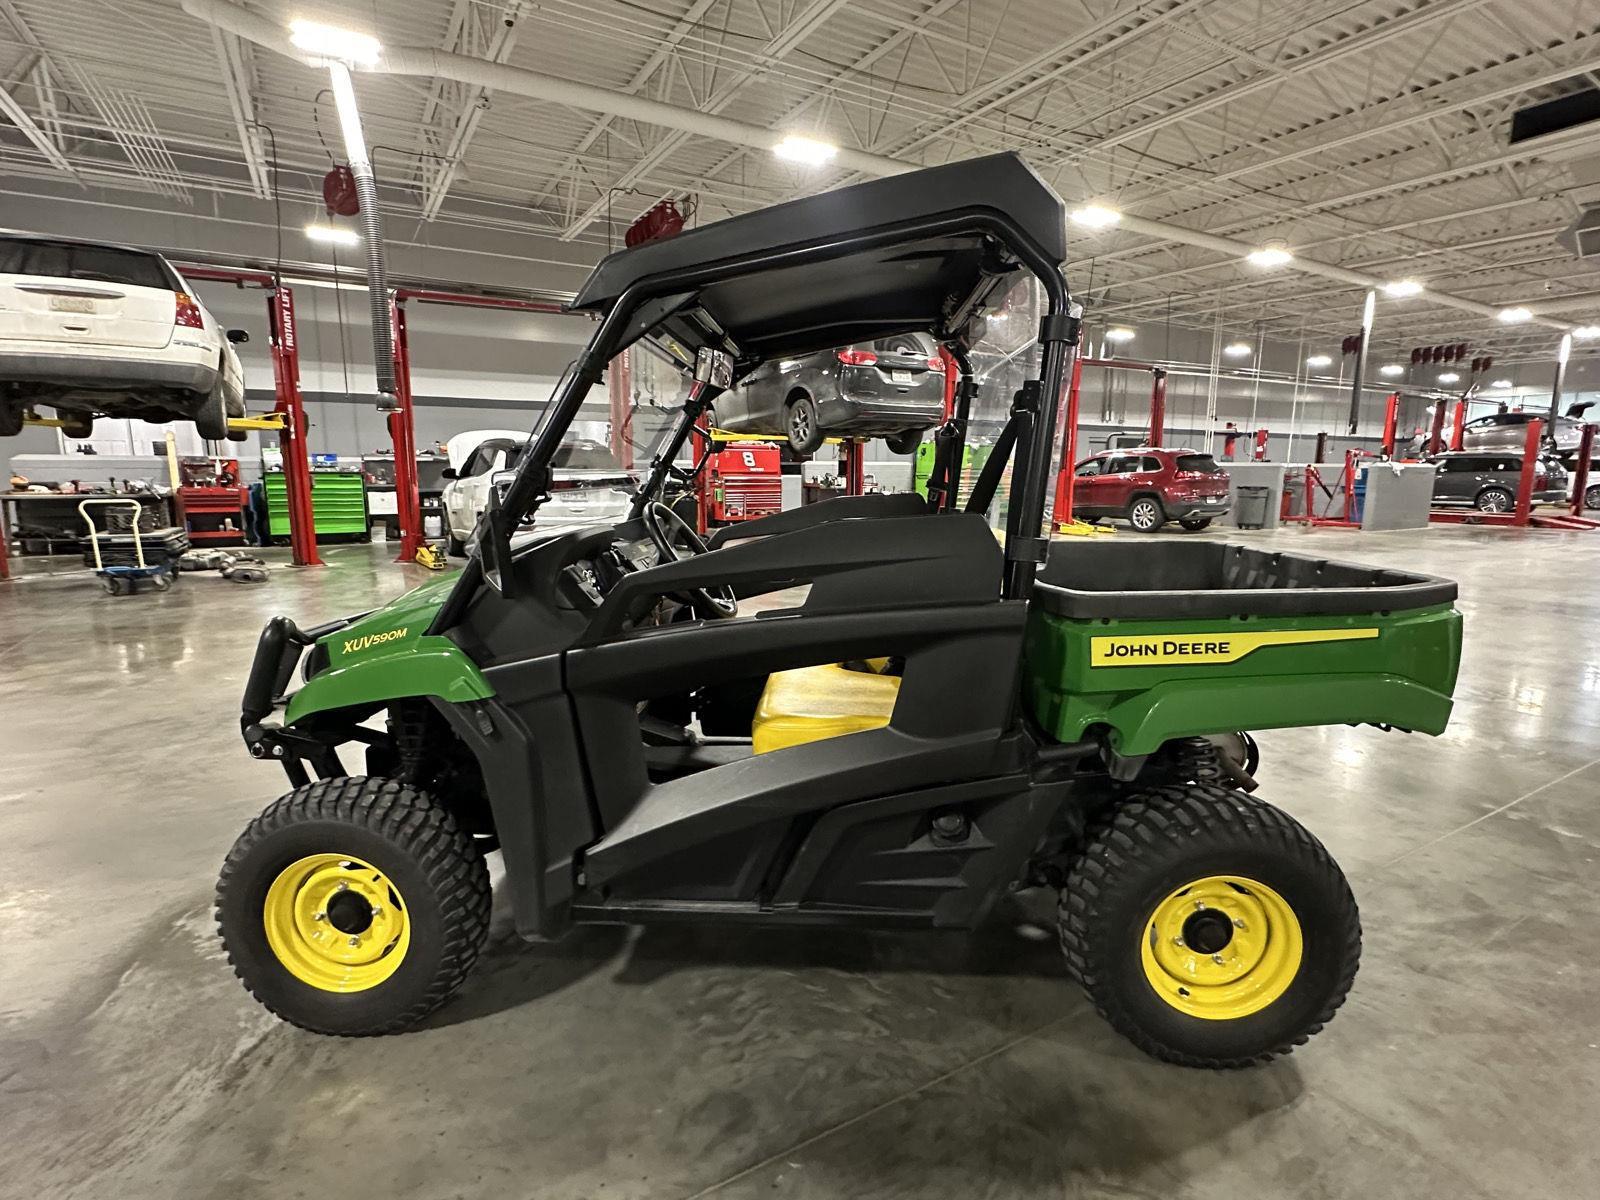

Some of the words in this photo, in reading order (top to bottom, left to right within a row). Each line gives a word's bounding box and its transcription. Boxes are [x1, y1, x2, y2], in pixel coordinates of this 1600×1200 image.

[281, 287, 290, 308] LIFT
[283, 309, 294, 347] ROTARY
[742, 451, 756, 467] 8
[342, 627, 408, 655] XUV590M
[1104, 643, 1158, 657] JOHN
[1163, 641, 1230, 655] DEERE
